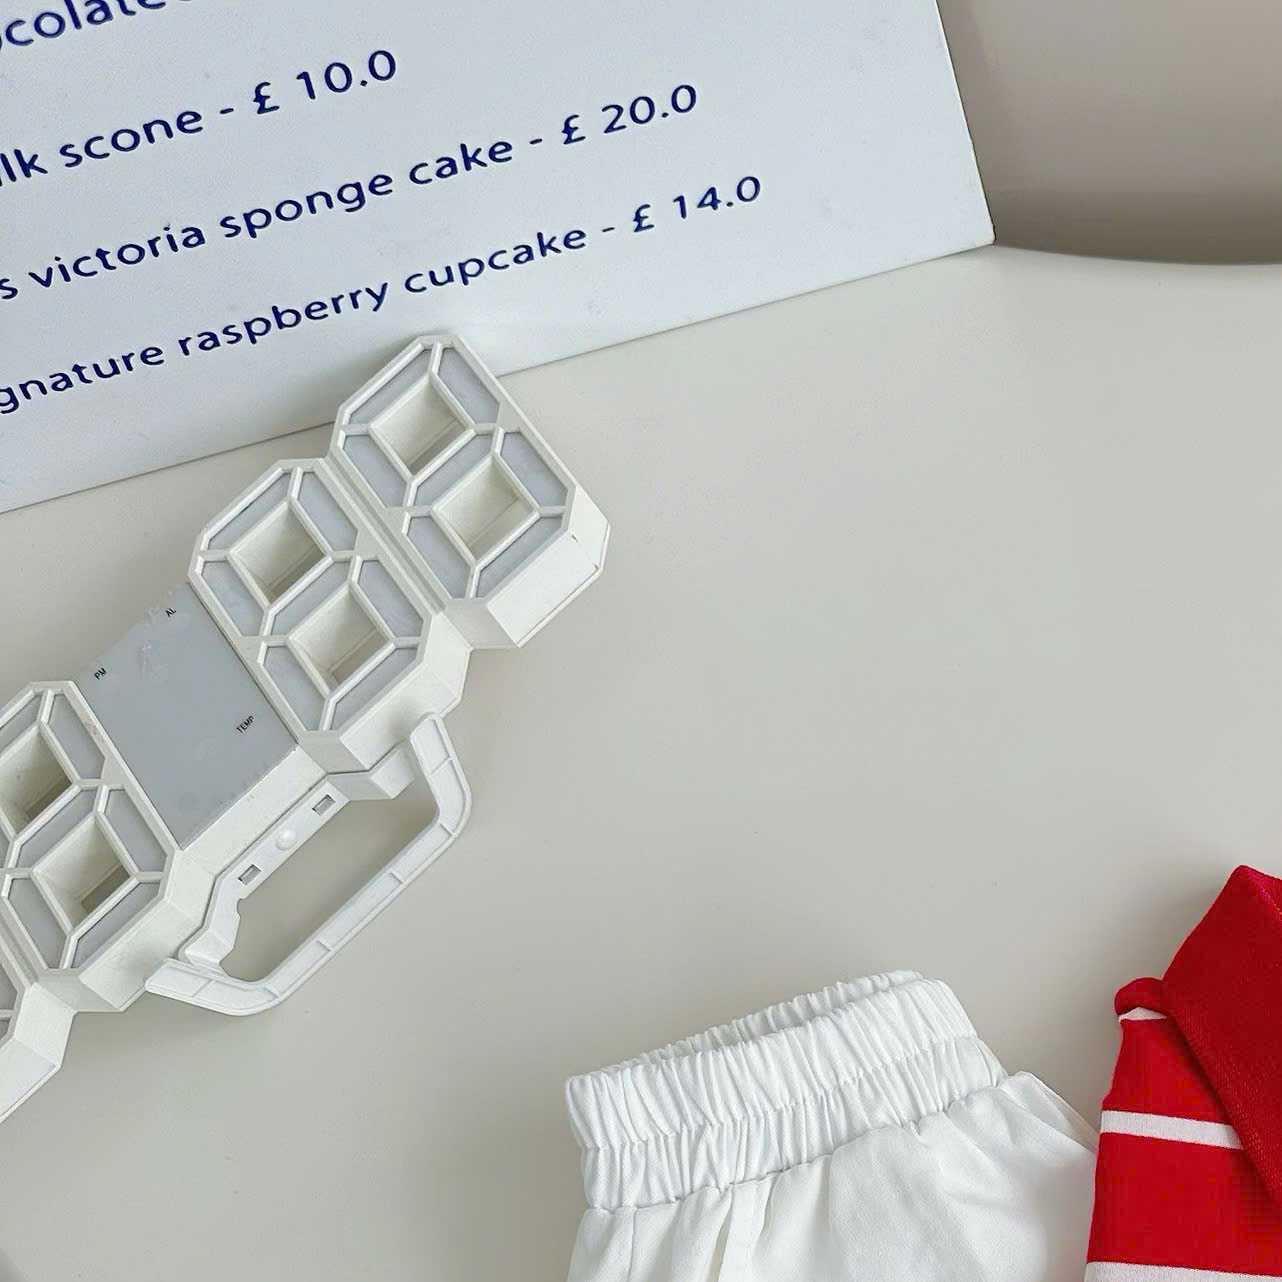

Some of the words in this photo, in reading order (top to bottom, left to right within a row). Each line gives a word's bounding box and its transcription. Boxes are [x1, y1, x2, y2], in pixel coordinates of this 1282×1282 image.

[59, 110, 204, 168] scone
[252, 81, 280, 115] £
[296, 50, 396, 100] 10.0
[27, 226, 206, 288] victoria
[219, 174, 393, 239] sponge
[408, 138, 513, 185] cake
[561, 114, 586, 145] £
[601, 84, 697, 134] 20.0
[178, 282, 388, 357] raspberry
[404, 229, 587, 293] cupcake
[632, 203, 655, 233] £
[672, 176, 761, 220] 14.0
[93, 667, 107, 680] PM
[236, 715, 254, 733] TEMP
